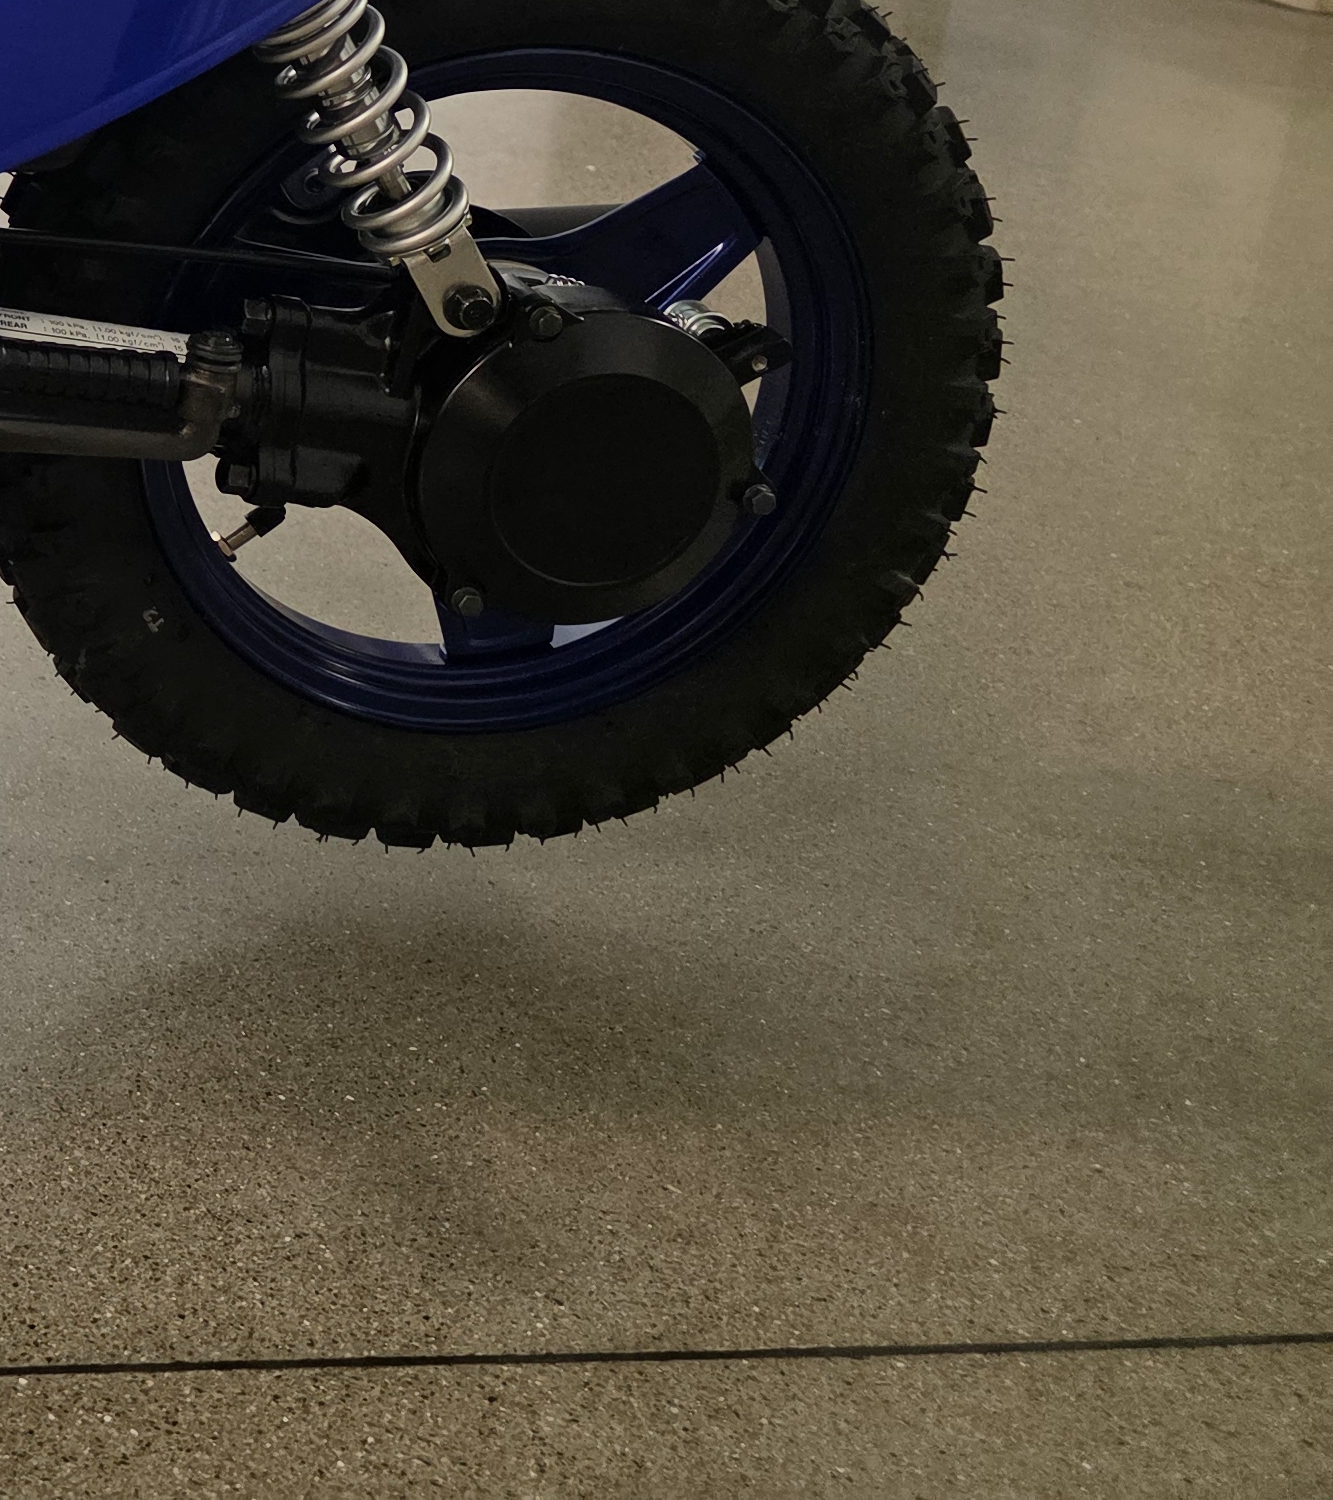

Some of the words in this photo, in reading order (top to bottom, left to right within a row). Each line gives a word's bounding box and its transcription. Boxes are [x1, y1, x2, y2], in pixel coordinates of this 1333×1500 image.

[0, 320, 28, 330] REAR
[51, 327, 67, 336] 100
[174, 345, 184, 353] 15
